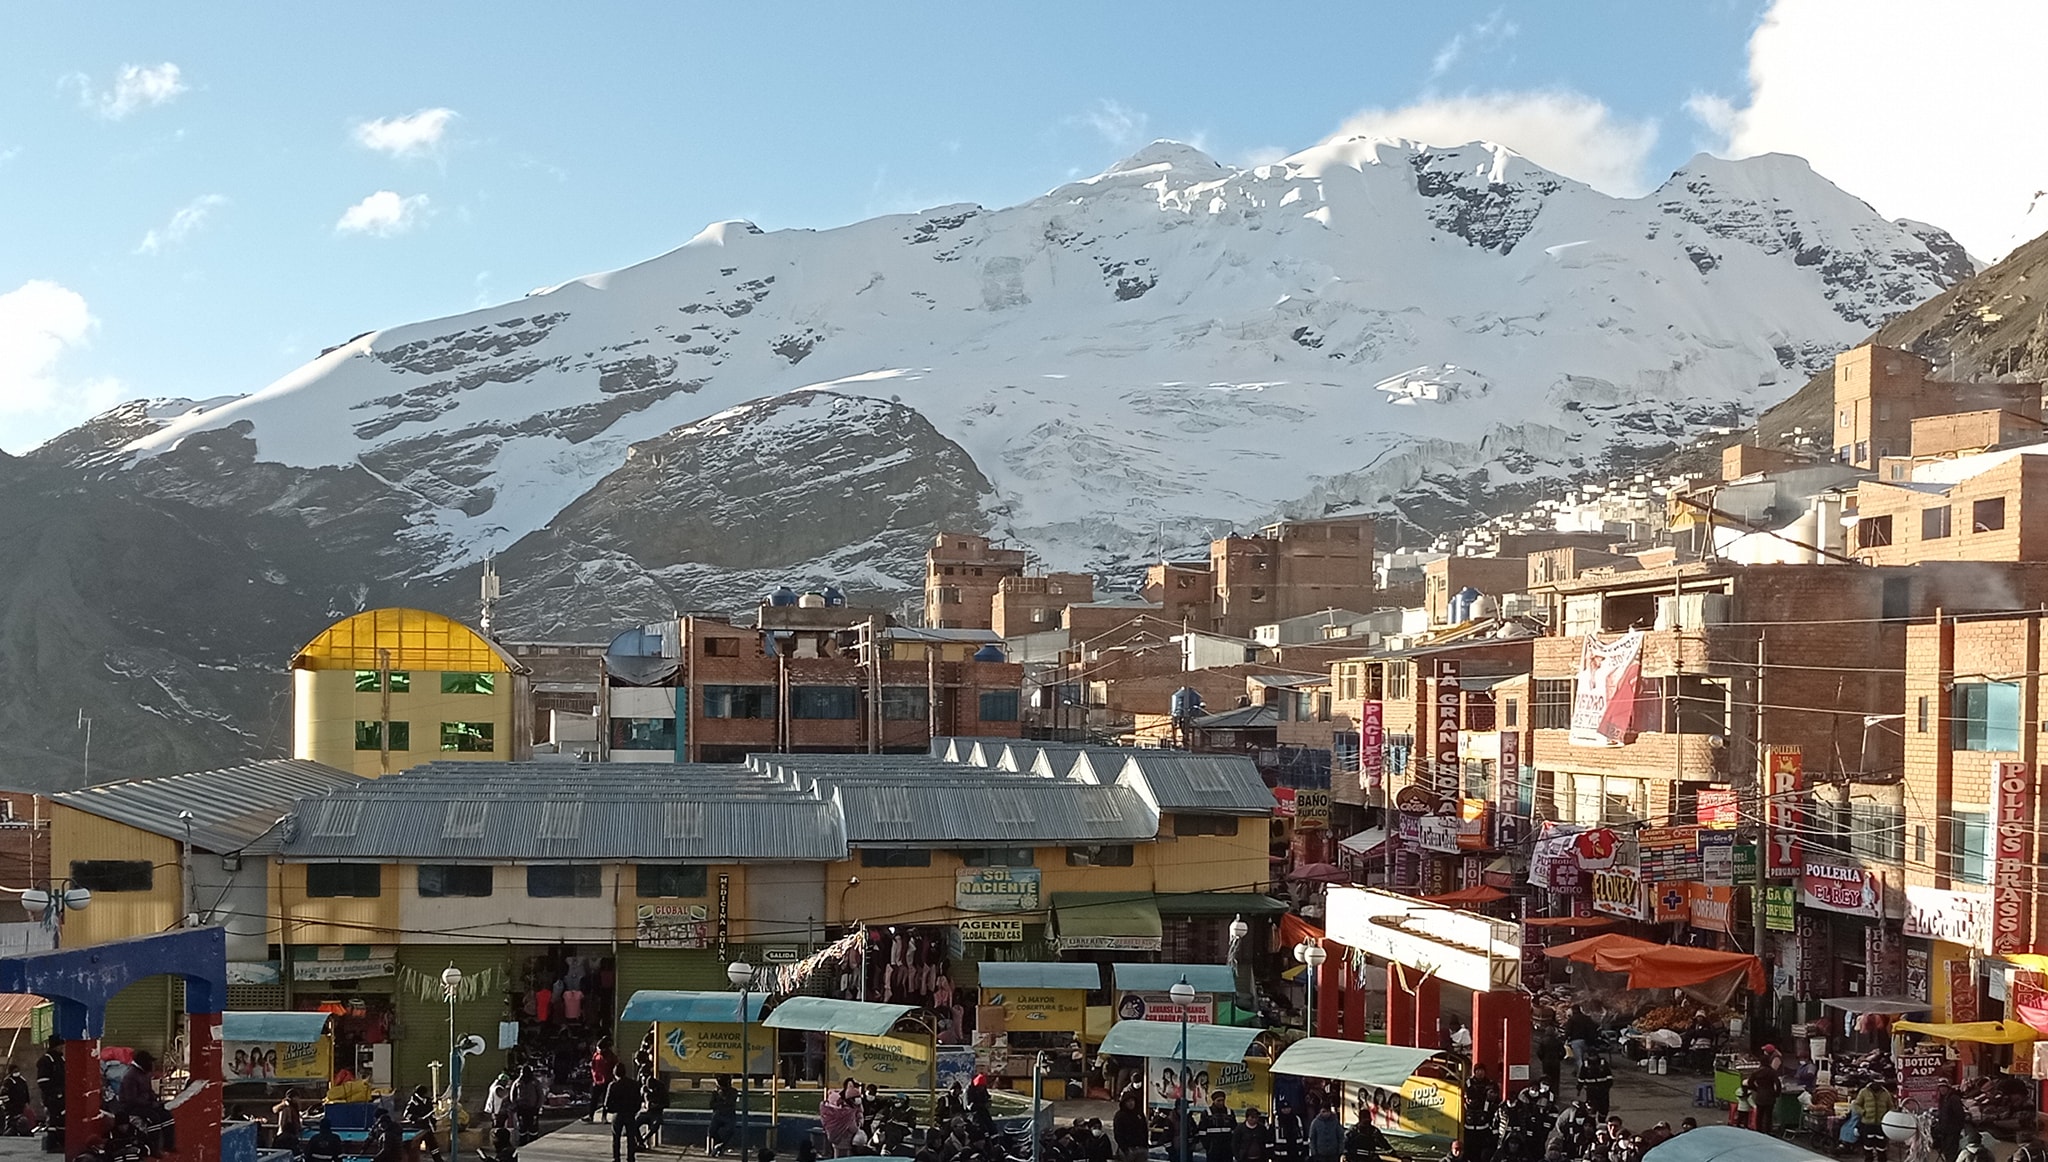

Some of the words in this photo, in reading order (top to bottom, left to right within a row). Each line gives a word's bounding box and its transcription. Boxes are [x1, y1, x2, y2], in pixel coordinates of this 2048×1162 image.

[1439, 662, 1458, 687] LA
[1438, 693, 1459, 744] GRAN
[1298, 792, 1328, 807] BAÑO
[1502, 756, 1516, 843] DENTAL
[1999, 763, 2026, 853] POLLOS
[1774, 772, 1798, 863] REY
[982, 870, 1013, 881] SOL
[1805, 863, 1862, 883] POLLERIA
[960, 882, 1037, 894] NACIENTE
[720, 877, 728, 926] MEDICINA
[1814, 885, 1831, 903] EL
[1831, 887, 1860, 907] REY
[655, 905, 689, 916] GLOBAL
[960, 921, 1020, 930] AGENTE
[718, 930, 726, 961] CHINA
[1802, 916, 1813, 1002] POLLERIA
[1872, 928, 1884, 997] POLLER
[1016, 1004, 1056, 1012] COBERTURA
[698, 1031, 709, 1041] LA
[709, 1031, 741, 1041] MAYOR
[697, 1041, 743, 1050] COBERTURA
[862, 1051, 903, 1062] COBERTURA
[1905, 1057, 1942, 1067] BOTICA
[1221, 1062, 1247, 1076] TODO
[1911, 1067, 1936, 1076] AQP
[1215, 1073, 1255, 1086] ILIMITADO
[1411, 1086, 1438, 1100] TODO
